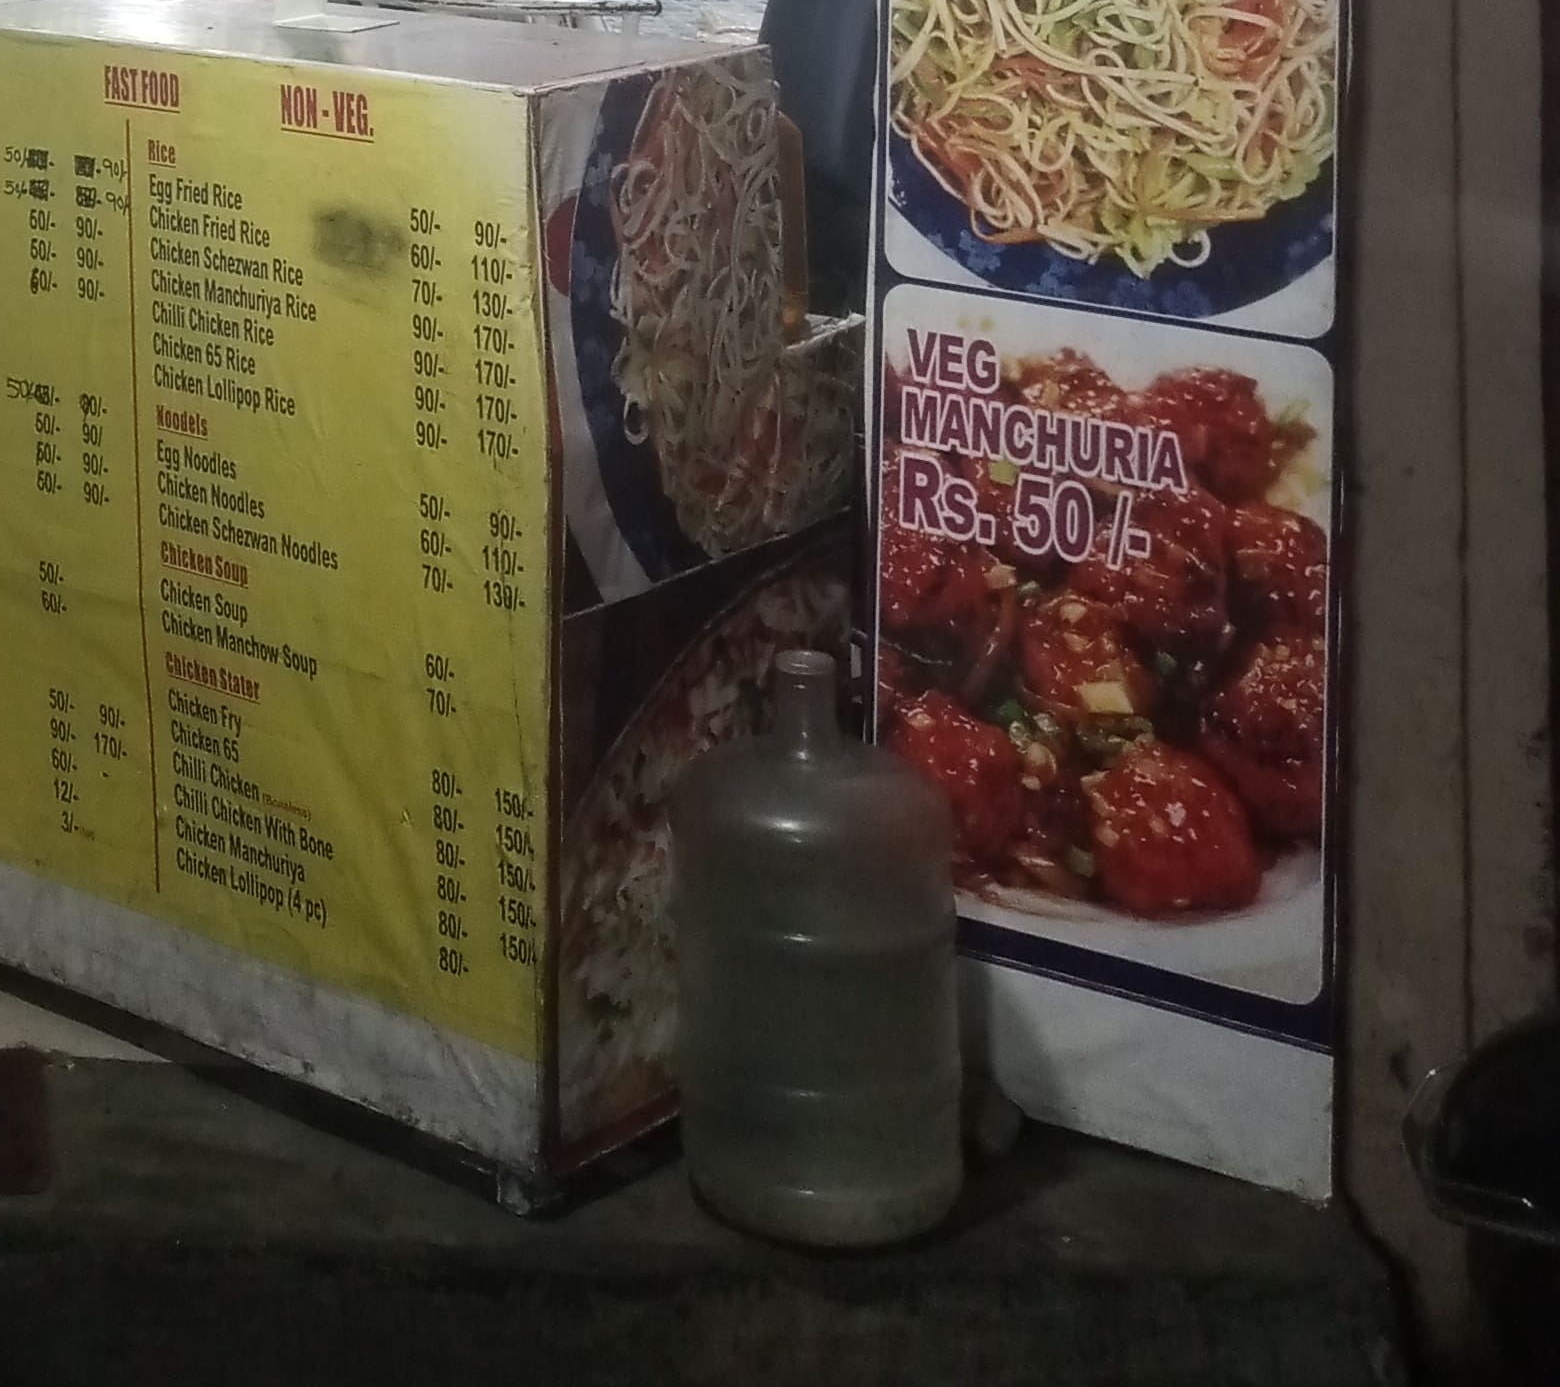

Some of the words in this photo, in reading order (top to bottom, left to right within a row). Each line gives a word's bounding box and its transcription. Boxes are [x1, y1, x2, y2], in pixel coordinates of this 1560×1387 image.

[104, 65, 138, 102] FAST
[141, 72, 180, 108] FOOD
[280, 84, 318, 128] NON
[149, 174, 172, 204] Egg
[177, 179, 208, 206] Fried
[213, 184, 242, 210] Rice
[150, 206, 198, 235] Chicken
[204, 214, 236, 242] Fried
[240, 221, 270, 248] Rice
[150, 237, 199, 269] Chicken
[204, 246, 268, 280] Schezwan
[273, 259, 303, 286] Rice
[151, 269, 200, 300] Chicken
[205, 278, 281, 320] Manchuriya
[286, 294, 316, 321] Rice
[152, 301, 185, 329] Chilli
[189, 308, 239, 339] Chicken
[244, 320, 274, 346] Rice
[153, 333, 202, 364] Chicken
[206, 342, 222, 368] 65
[226, 348, 256, 376] Rice
[906, 327, 998, 393] VEG
[154, 366, 203, 396] Chicken
[207, 374, 260, 410] Lollipop
[265, 389, 296, 416] Rice
[157, 440, 179, 471] Egg
[185, 443, 236, 479] Noodles
[900, 387, 1188, 494] MANCHURIA
[158, 471, 207, 504] Chicken
[212, 483, 265, 519] Noodles
[898, 450, 995, 545] Rs.
[1013, 475, 1095, 564] 50
[159, 503, 208, 535] Chicken
[213, 516, 277, 555] Schezwan
[282, 534, 338, 570] Noodles
[161, 578, 210, 613] Chicken
[215, 594, 247, 625] Soup
[162, 612, 212, 645] Chicken
[217, 626, 278, 665] Manchow
[283, 647, 317, 680] Soup
[169, 689, 218, 724] Chicken
[221, 706, 241, 738] Fry
[171, 720, 220, 755] Chicken
[224, 737, 239, 763] 65
[173, 751, 207, 783] Chilli
[211, 764, 260, 802] Chicken
[175, 784, 208, 816] Chilli
[212, 797, 262, 834] Chicken
[266, 815, 295, 846] With
[300, 827, 334, 861] Bone
[176, 815, 226, 853] Chicken
[230, 834, 305, 883] Manchuriya
[177, 849, 227, 886] Chicken
[231, 867, 284, 912] Lollipop
